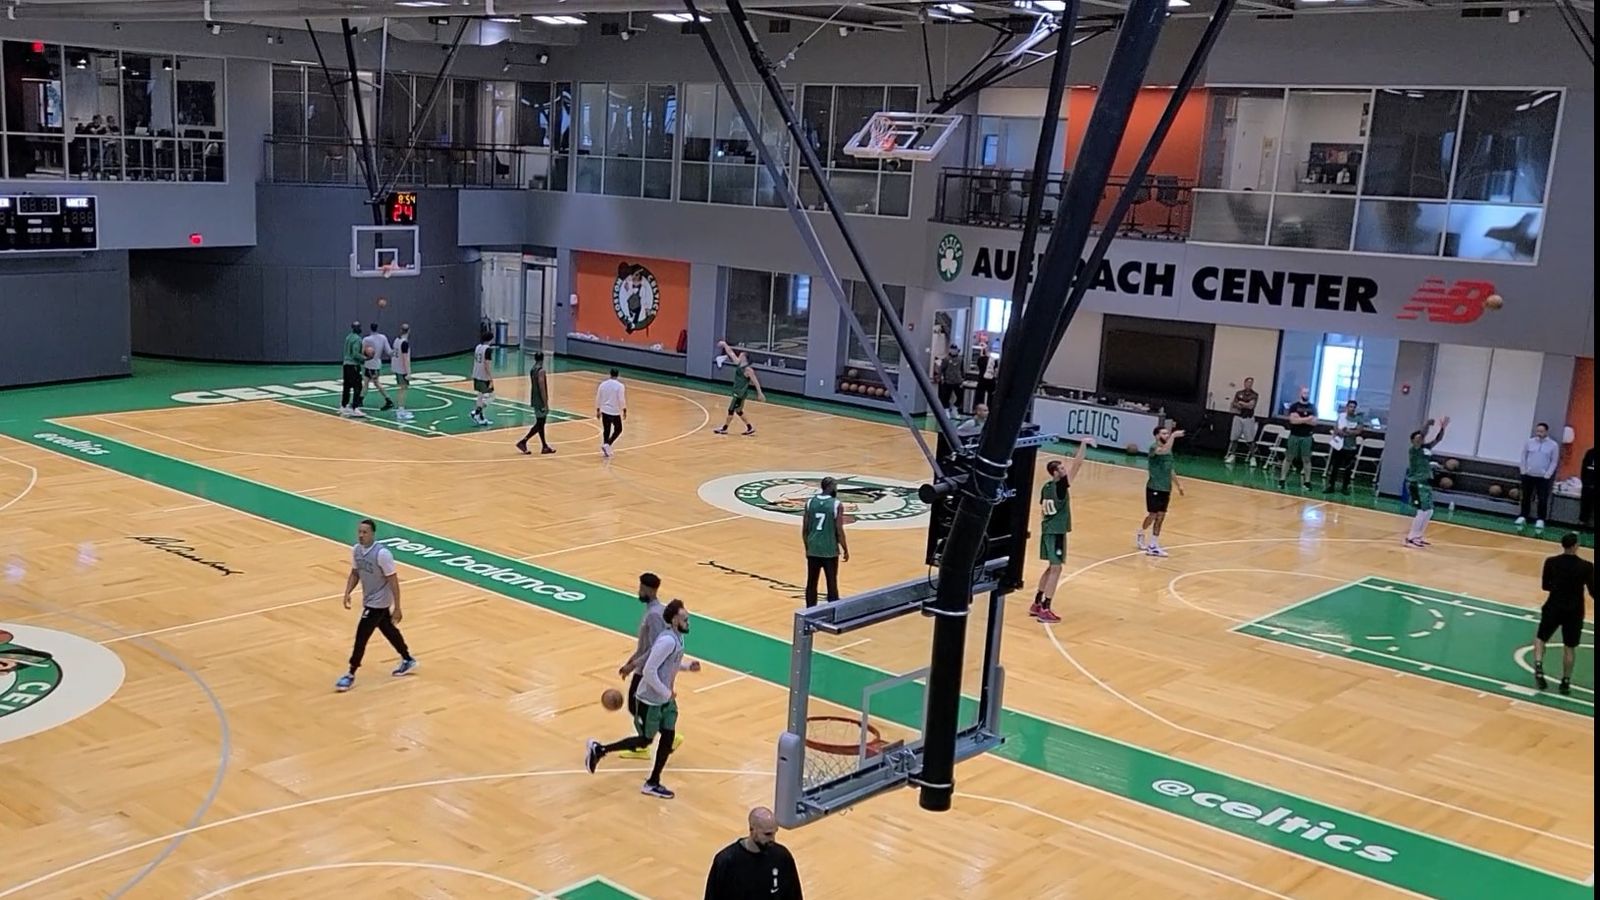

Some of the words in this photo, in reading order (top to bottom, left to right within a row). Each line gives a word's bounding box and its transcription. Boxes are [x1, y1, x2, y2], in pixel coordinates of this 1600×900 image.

[393, 204, 413, 222] 24
[938, 236, 962, 258] CELTICS
[971, 246, 1176, 297] AUACH
[1191, 266, 1379, 313] CENTER
[1067, 409, 1120, 442] CELTICS
[815, 512, 826, 531] 7
[378, 537, 453, 559] new
[440, 555, 586, 602] balance
[1151, 780, 1399, 862] @celtics
